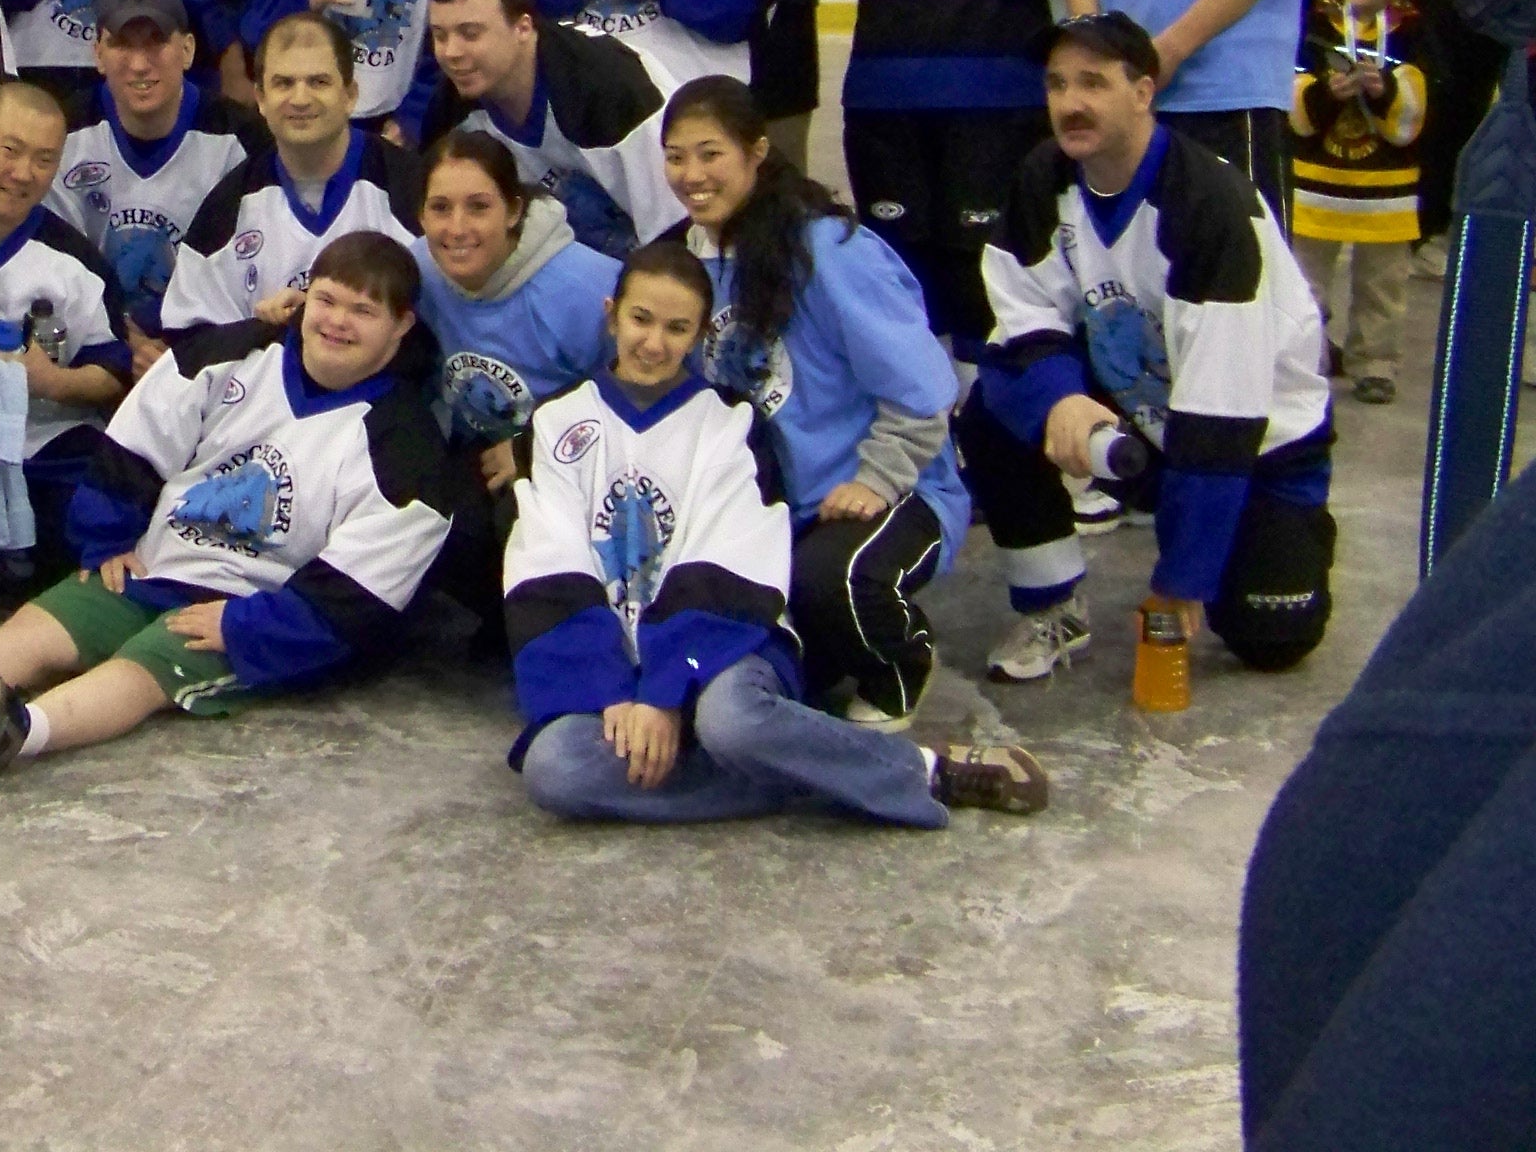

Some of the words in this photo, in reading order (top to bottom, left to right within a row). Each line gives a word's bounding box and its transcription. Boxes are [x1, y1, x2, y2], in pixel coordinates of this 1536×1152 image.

[50, 8, 96, 42] ICEC
[109, 208, 184, 247] CHEST
[595, 473, 676, 546] ROCSTER
